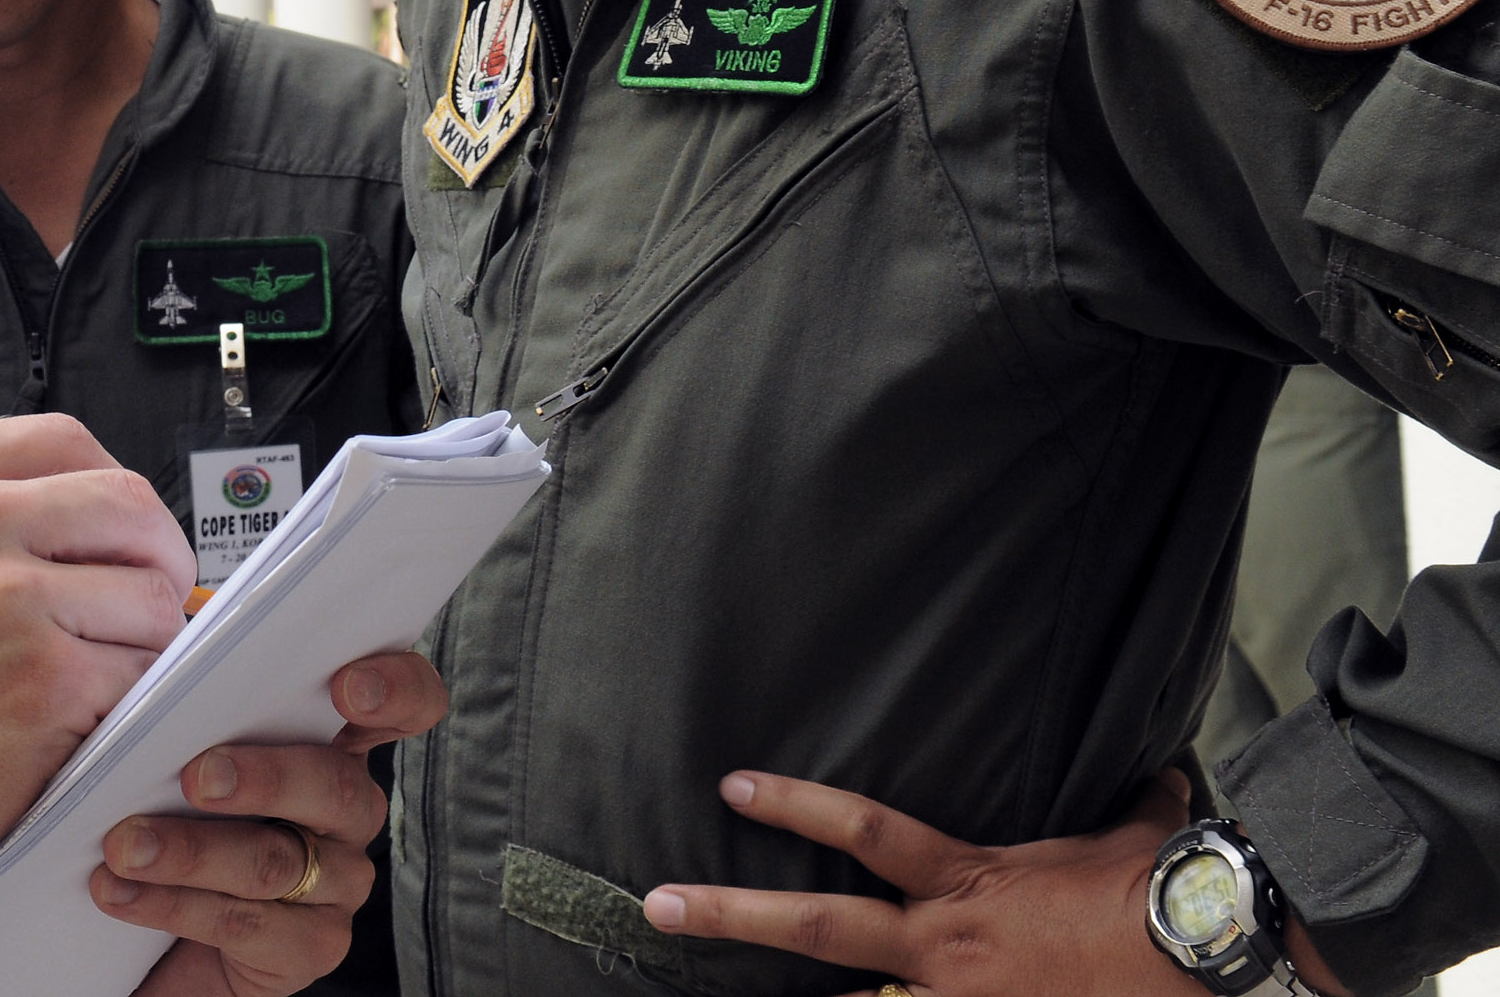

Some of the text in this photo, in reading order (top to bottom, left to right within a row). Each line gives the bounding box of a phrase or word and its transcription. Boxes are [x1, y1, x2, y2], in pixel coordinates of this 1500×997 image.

[714, 47, 782, 74] VIKING
[438, 109, 516, 167] WING 4
[245, 309, 286, 325] BUG
[200, 512, 279, 537] COPE TIGER
[198, 540, 228, 551] WING
